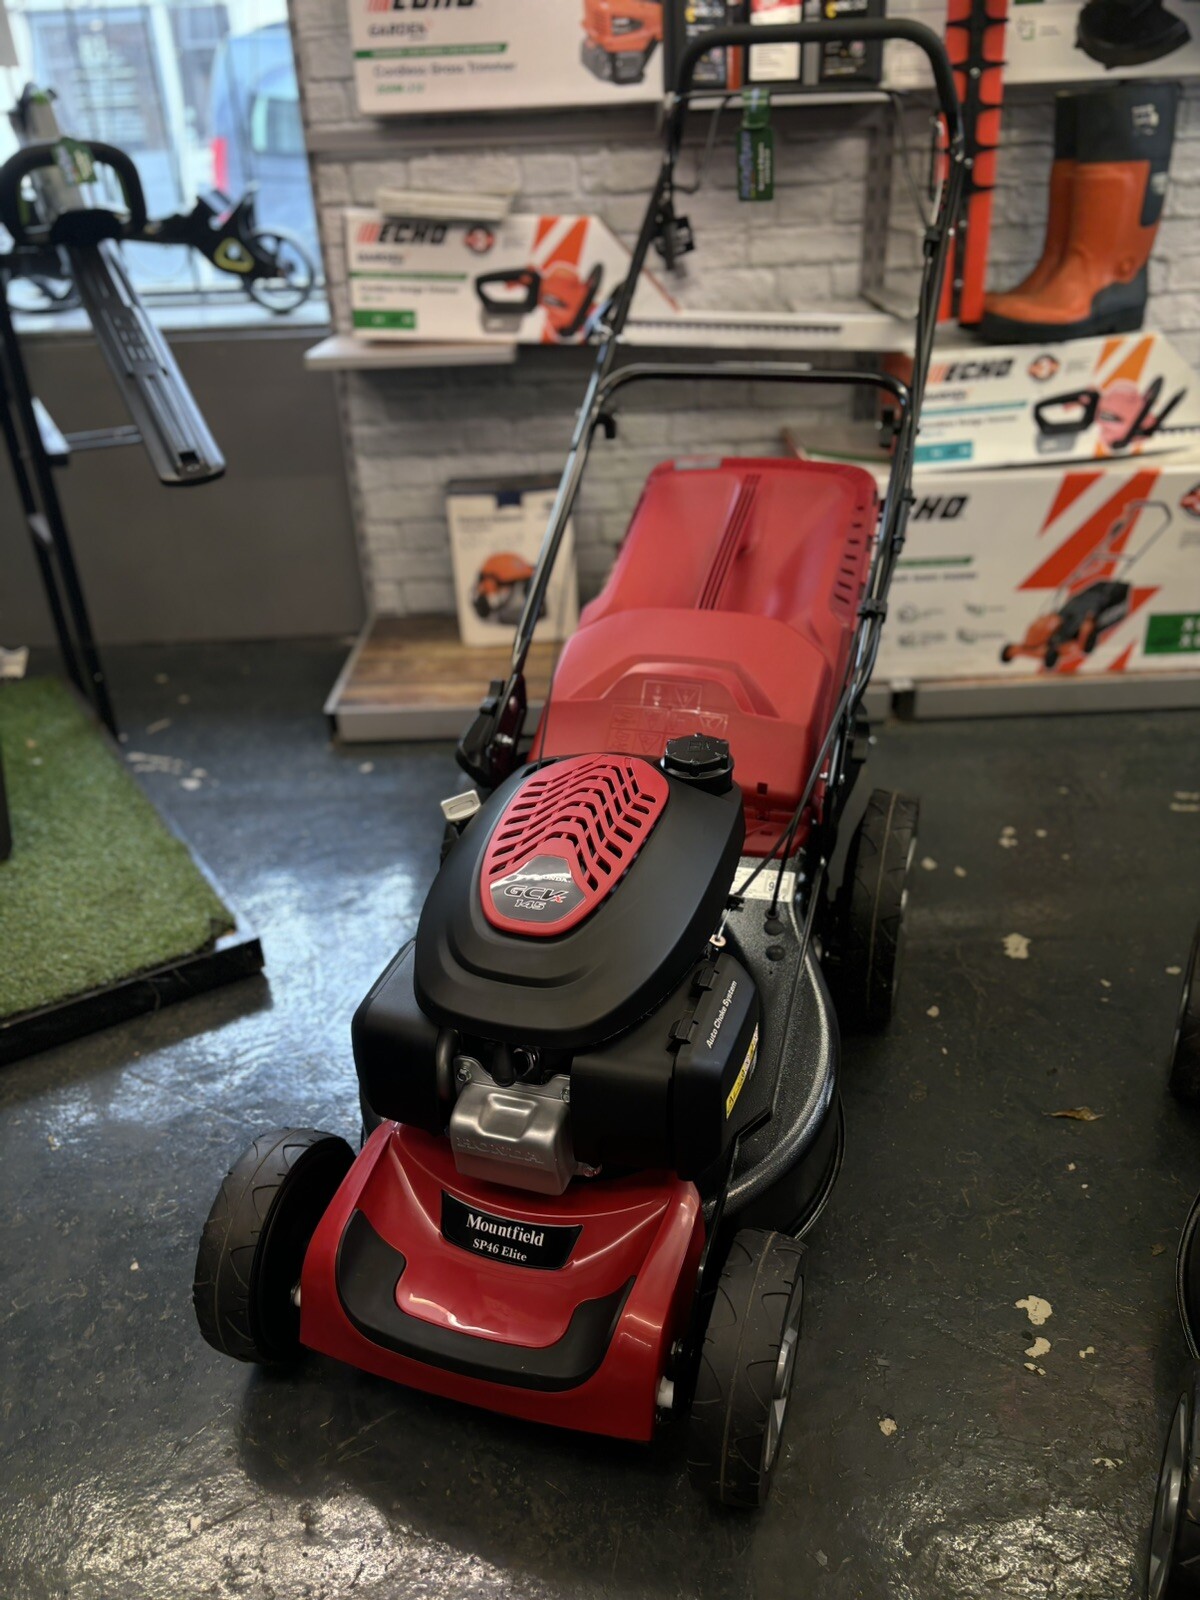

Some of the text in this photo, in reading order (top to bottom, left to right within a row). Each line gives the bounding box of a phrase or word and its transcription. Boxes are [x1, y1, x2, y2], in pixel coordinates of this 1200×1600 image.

[378, 222, 448, 244] ECHO
[945, 358, 1015, 381] ECHO
[910, 494, 969, 522] HO
[705, 980, 737, 1049] Auto Choke System
[465, 1213, 545, 1247] Mountfield
[472, 1238, 528, 1262] SP46 Elite
